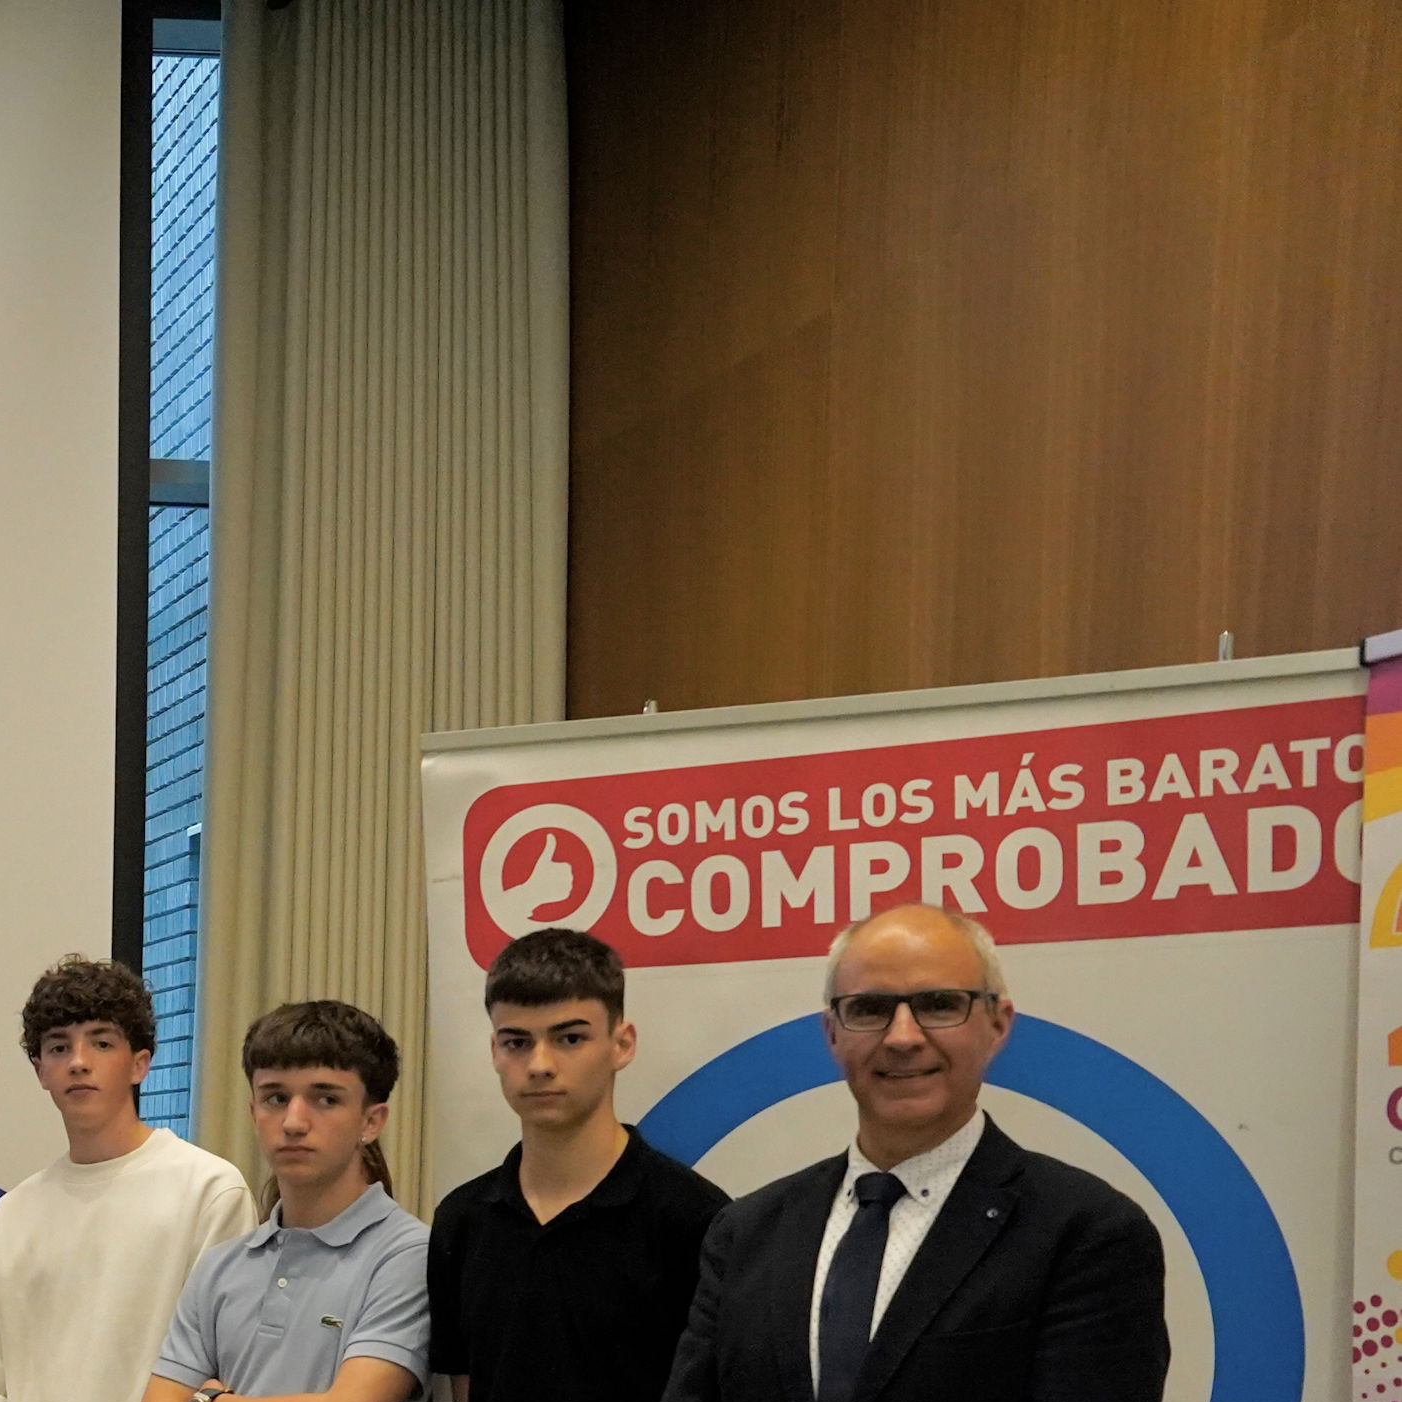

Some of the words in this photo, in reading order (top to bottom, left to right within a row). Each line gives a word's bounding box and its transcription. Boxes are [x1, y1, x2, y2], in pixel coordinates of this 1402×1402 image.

[622, 791, 810, 849] SOMOS
[828, 778, 934, 831] LOS
[954, 752, 1085, 820] MÁS
